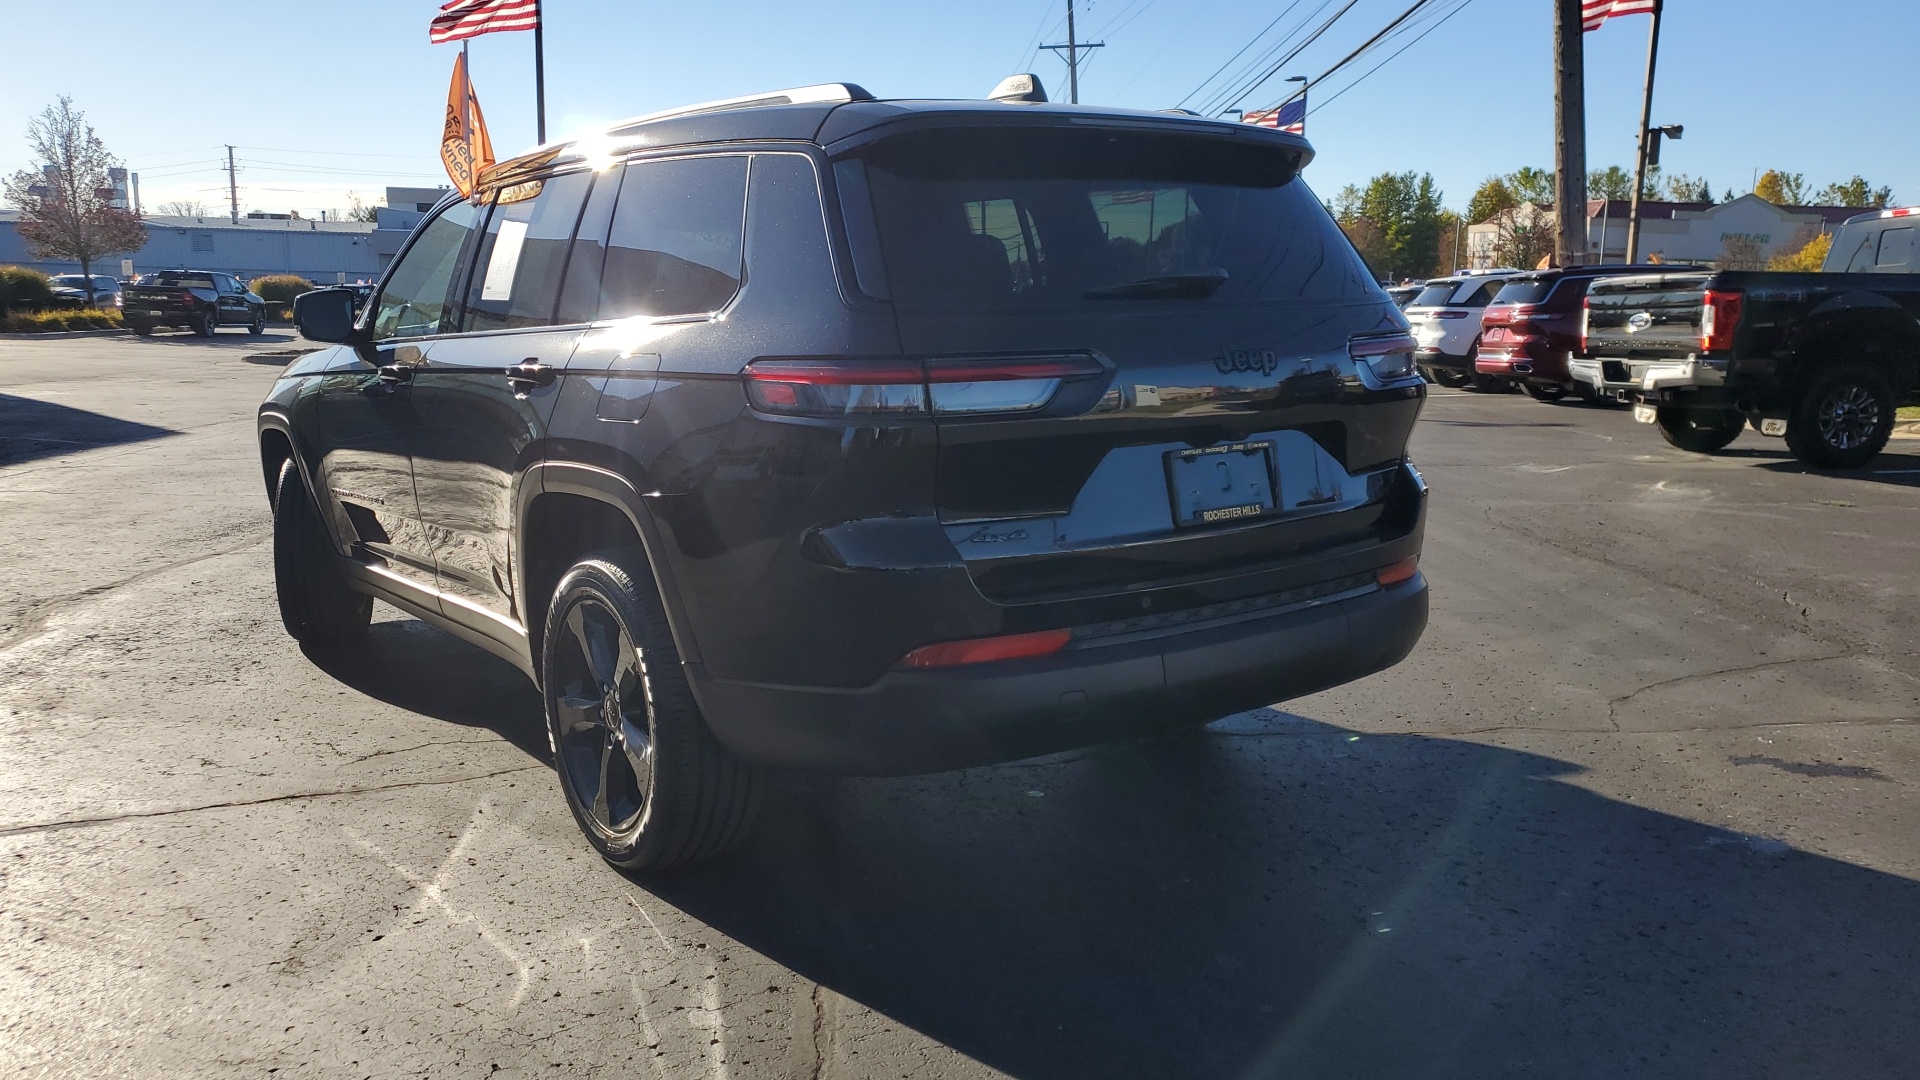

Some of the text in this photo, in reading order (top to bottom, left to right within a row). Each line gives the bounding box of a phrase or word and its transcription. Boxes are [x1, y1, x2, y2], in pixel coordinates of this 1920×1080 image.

[1214, 344, 1278, 377] Jeep
[1203, 504, 1261, 522] ROCHESTER HILLS
